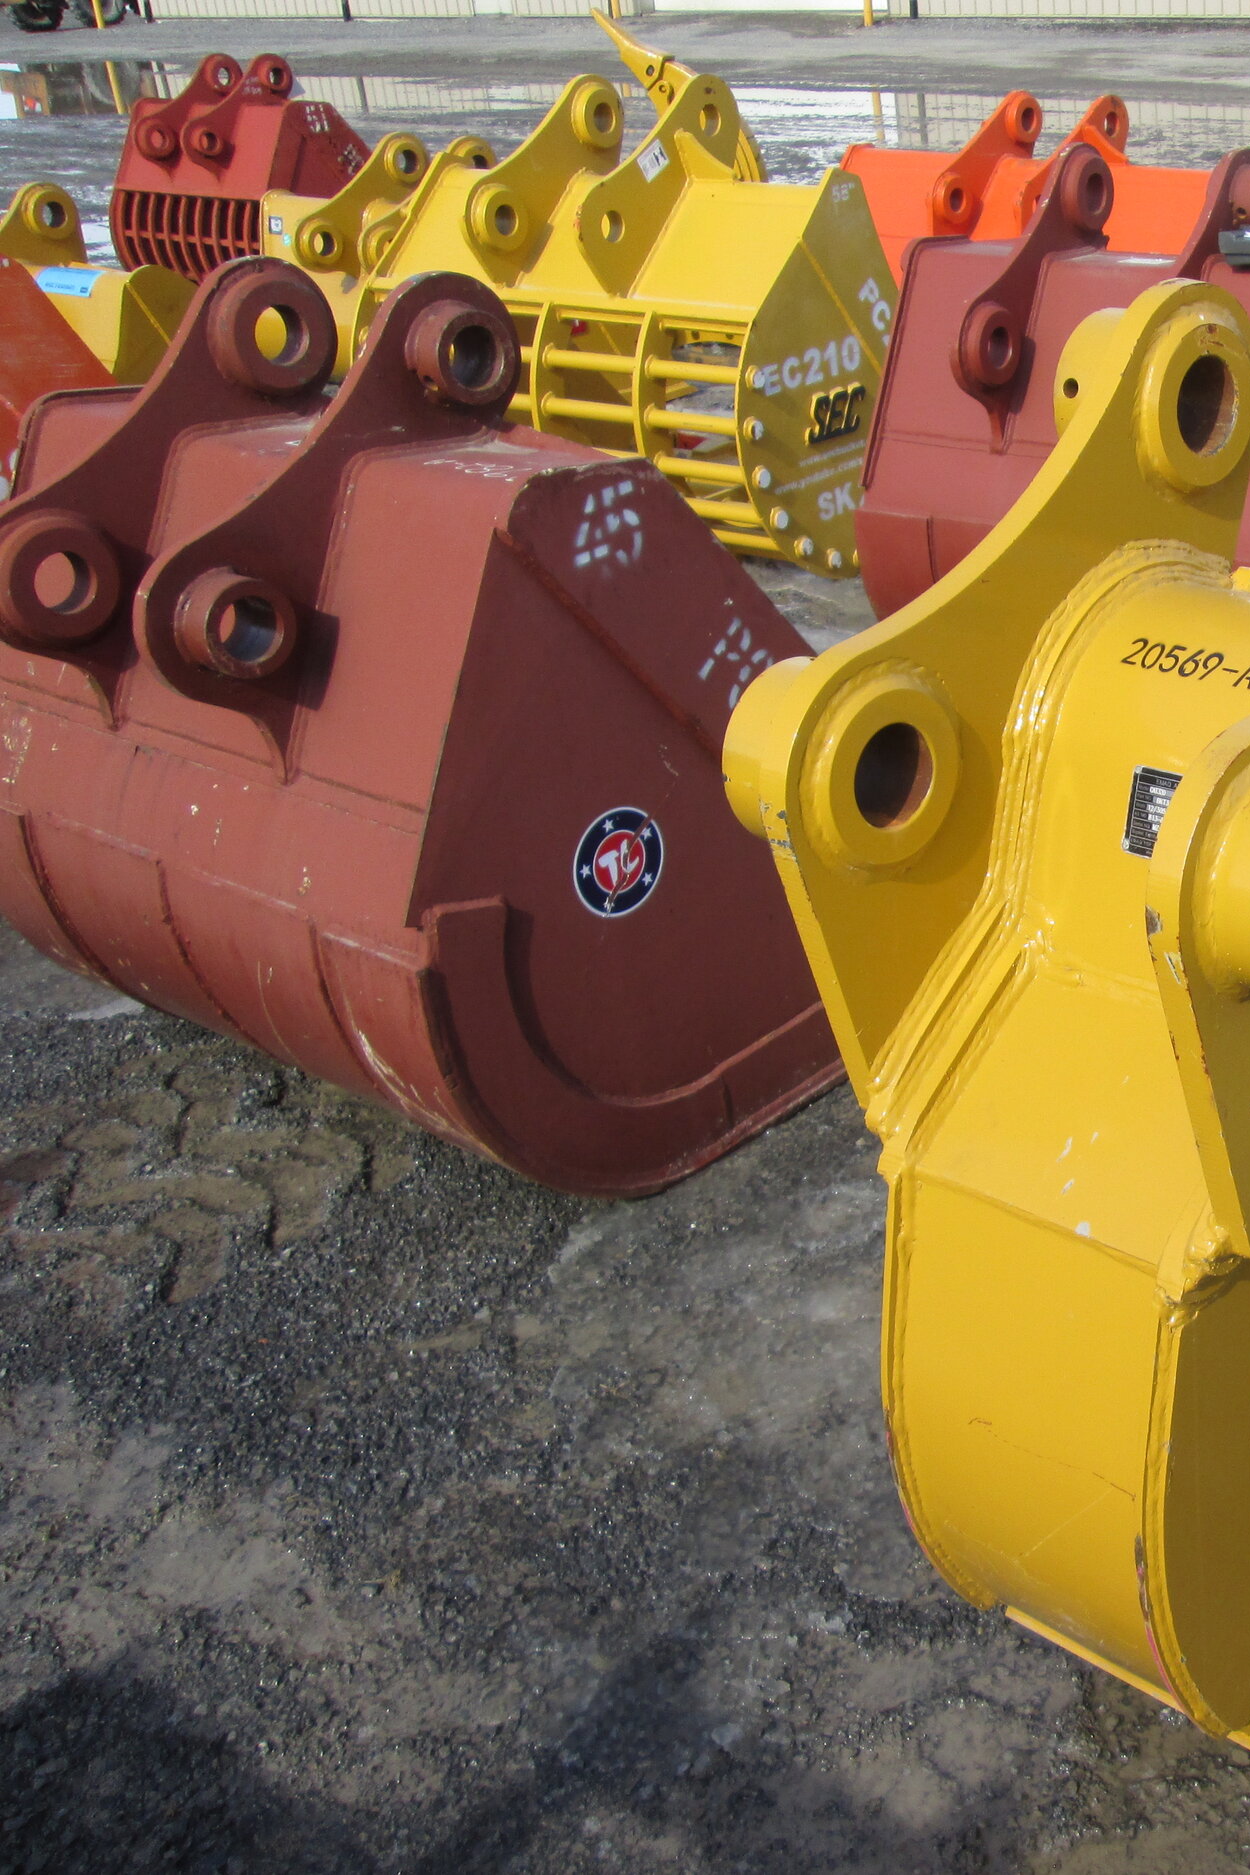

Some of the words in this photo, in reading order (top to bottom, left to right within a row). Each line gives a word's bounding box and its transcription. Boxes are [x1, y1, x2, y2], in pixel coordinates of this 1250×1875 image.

[764, 334, 861, 396] EC210
[804, 381, 866, 446] SEC
[574, 480, 643, 566] 45
[817, 482, 864, 521] SK
